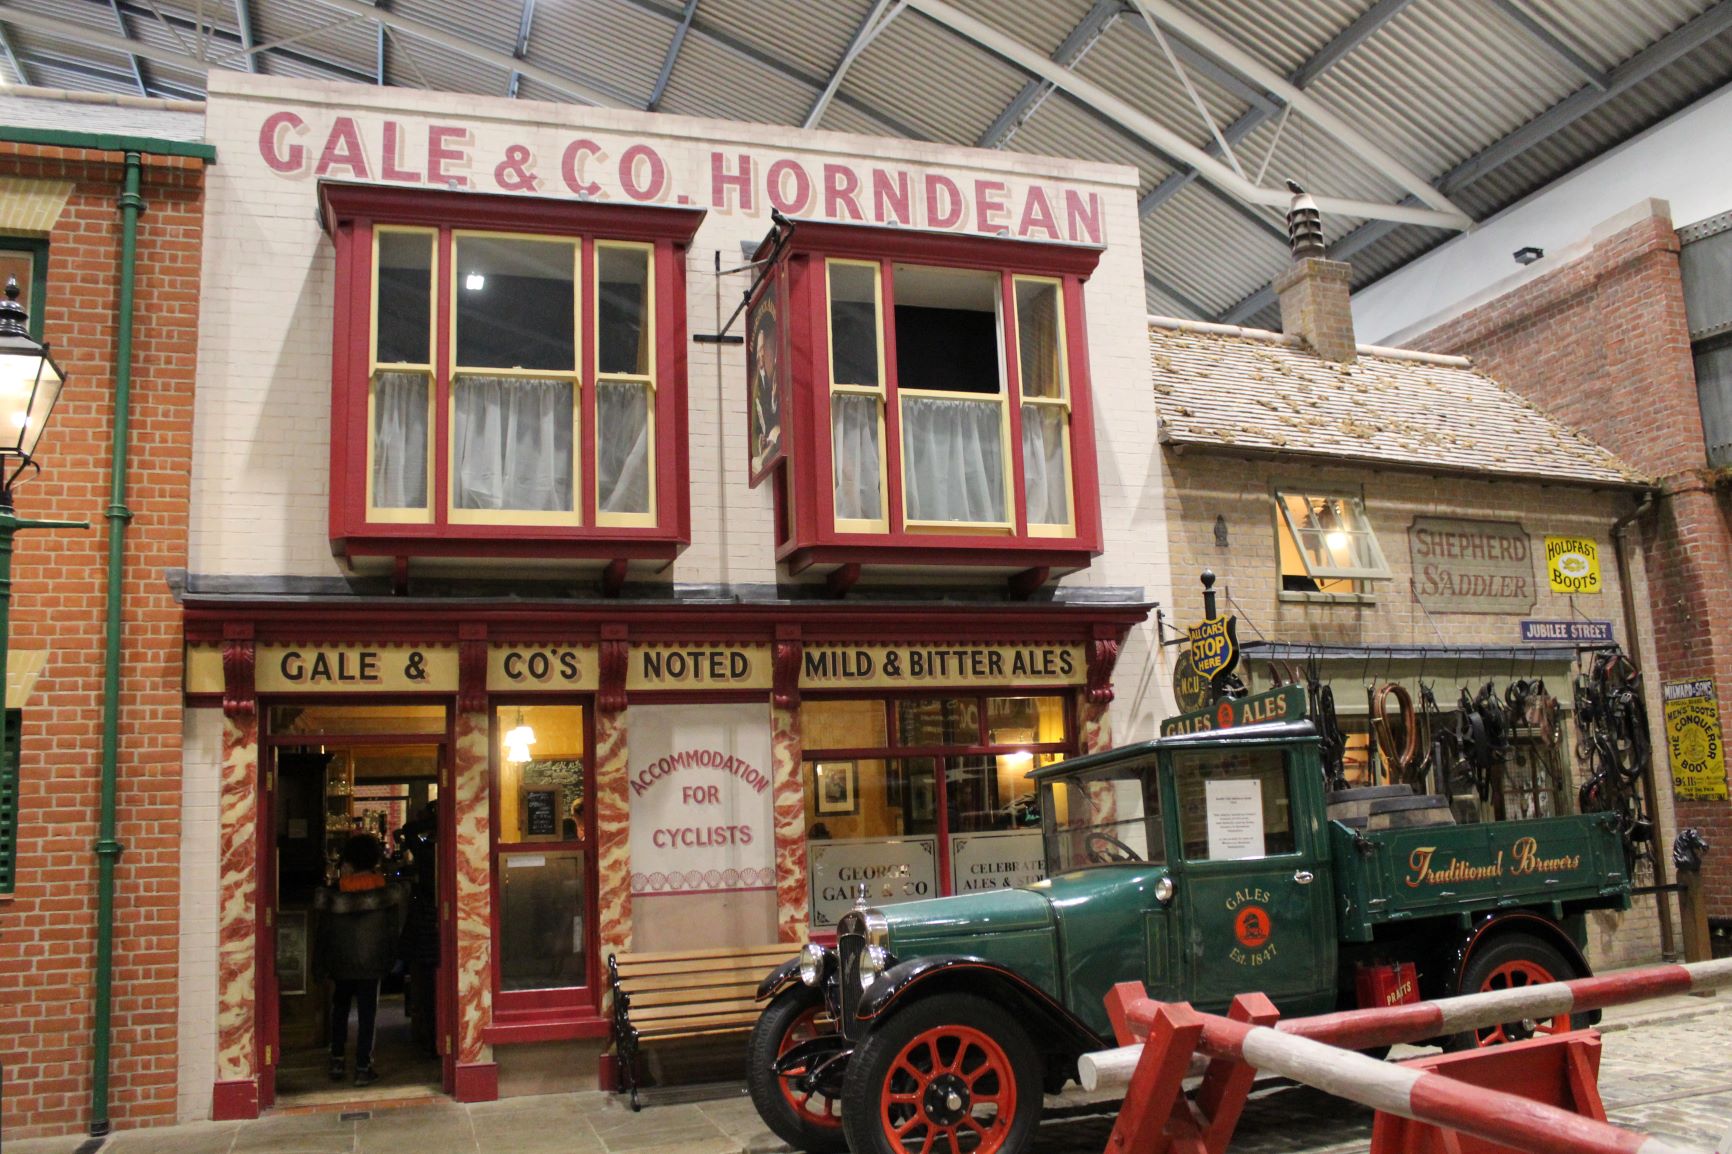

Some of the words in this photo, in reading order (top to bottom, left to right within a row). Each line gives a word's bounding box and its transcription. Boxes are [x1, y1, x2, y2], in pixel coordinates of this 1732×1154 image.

[259, 111, 472, 187] GALE
[494, 144, 540, 193] &
[562, 139, 690, 205] CO.
[710, 151, 1102, 244] HORNDEAN
[1415, 528, 1527, 562] SHEPHERD
[1547, 538, 1596, 561] HOLDFAST
[1421, 563, 1528, 598] SADDLER
[1552, 569, 1597, 590] BOOTS
[1190, 629, 1201, 640] ALL
[1201, 622, 1223, 637] CARS
[1526, 623, 1568, 639] JUBILEE
[1571, 624, 1608, 639] STREET
[1193, 636, 1226, 661] STOP
[280, 651, 380, 682] GALE
[404, 651, 427, 681] &
[503, 648, 579, 681] CO'S
[643, 650, 750, 679] NOTED
[805, 651, 875, 678] MILD
[882, 651, 901, 677] &
[909, 649, 1002, 677] BITTER
[1012, 648, 1074, 676] ALES
[1198, 656, 1222, 671] HERE
[1167, 714, 1212, 737] GALES
[1242, 693, 1287, 724] ALES
[1690, 705, 1716, 718] BOOTS
[1672, 735, 1682, 759] THE
[1674, 715, 1717, 760] CONQUEROR
[630, 749, 769, 797] ACCOMMODATION
[1680, 760, 1708, 773] BOOT
[682, 785, 721, 805] FOR
[653, 825, 753, 848] CYCLISTS
[838, 864, 911, 881] GEORGE
[1405, 846, 1504, 888] Traditional
[1510, 836, 1581, 876] Brewers
[903, 881, 928, 896] CO
[963, 877, 997, 890] ALES
[1002, 876, 1011, 887] &
[1225, 888, 1271, 911] GALES
[1251, 943, 1278, 966] 1847
[1386, 981, 1412, 1006] PRATTS
